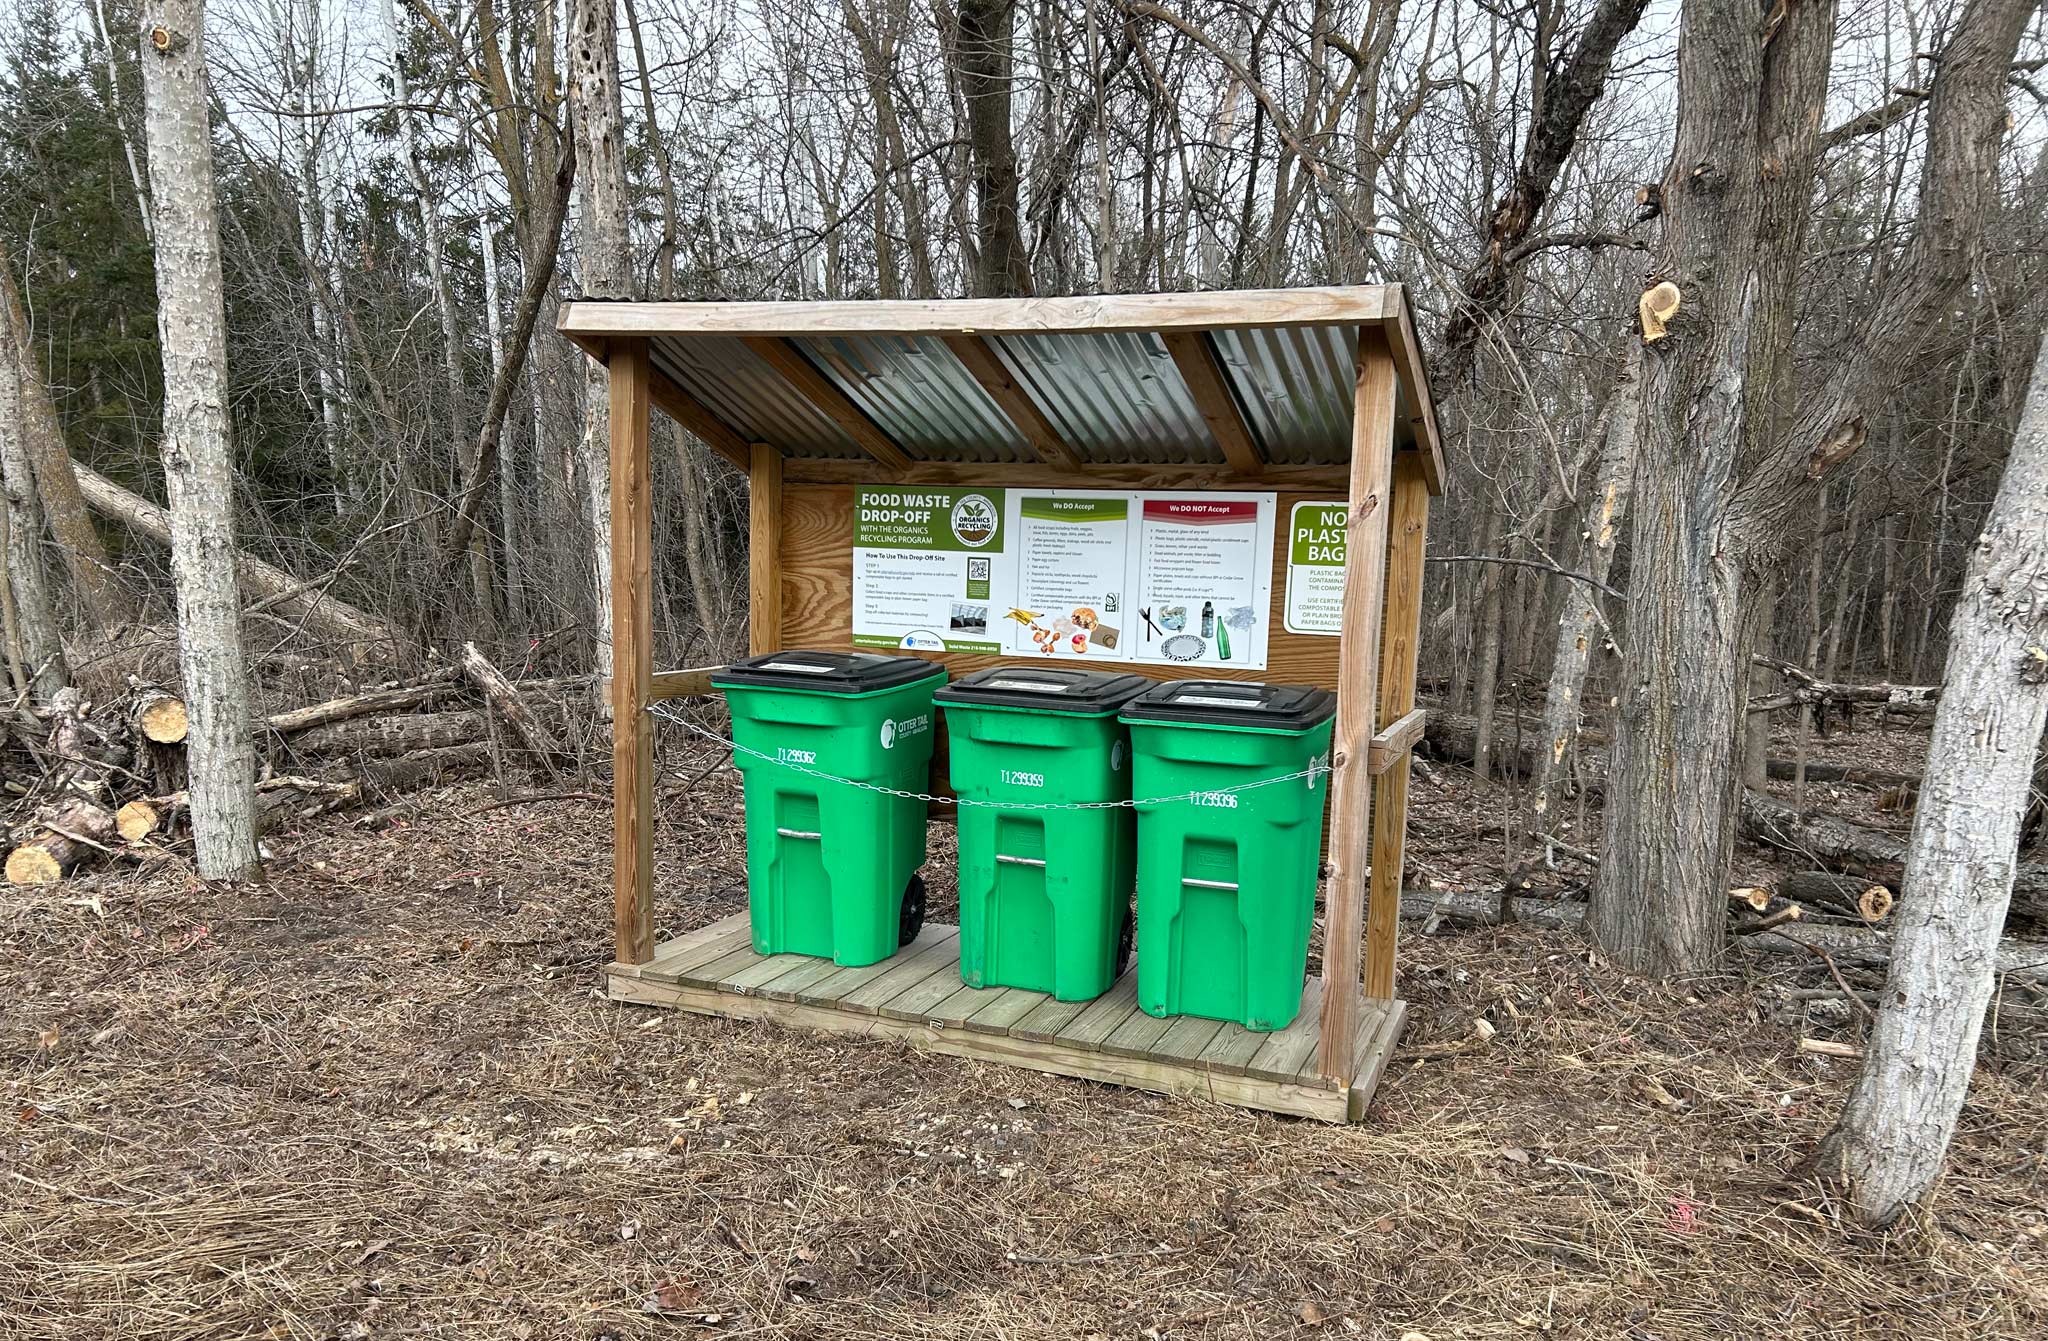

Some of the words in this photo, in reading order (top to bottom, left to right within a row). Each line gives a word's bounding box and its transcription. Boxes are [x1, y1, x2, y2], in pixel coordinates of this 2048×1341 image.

[861, 493, 900, 506] FOOD
[902, 494, 950, 508] WASTE
[1074, 503, 1095, 511] Accept
[861, 509, 931, 524] DROP-OFF
[1207, 506, 1230, 514] Accept
[1320, 511, 1348, 527] NO
[879, 525, 892, 533] THE
[893, 526, 928, 534] ORGANICS
[860, 535, 897, 543] RECYCLING
[899, 536, 933, 544] PROGRAM
[1308, 546, 1345, 561] BAG
[899, 718, 917, 733] OTTER
[917, 714, 928, 726] TAIL
